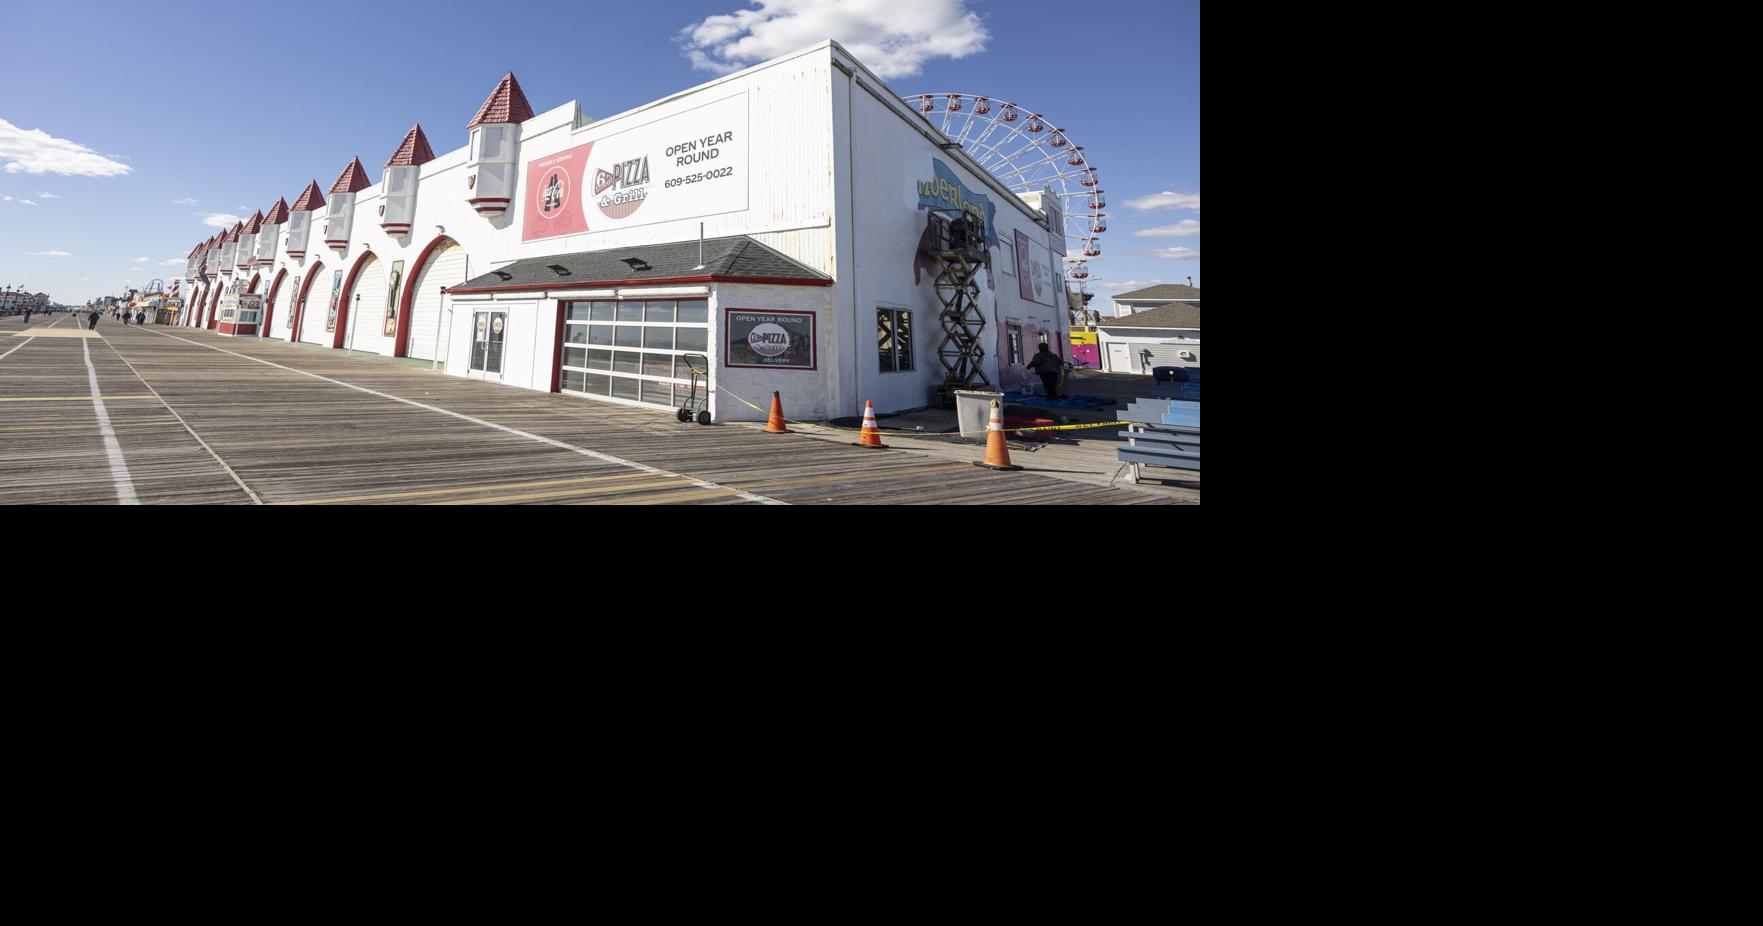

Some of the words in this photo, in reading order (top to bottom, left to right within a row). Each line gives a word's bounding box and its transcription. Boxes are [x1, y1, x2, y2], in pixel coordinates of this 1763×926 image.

[665, 140, 697, 157] OPEN
[699, 131, 732, 148] YEAR
[676, 148, 719, 167] ROUND
[612, 153, 650, 190] PIZZA
[664, 166, 733, 188] 609-525-0022
[600, 194, 611, 208] &
[613, 187, 645, 205] Grill
[762, 332, 787, 345] PIZZA
